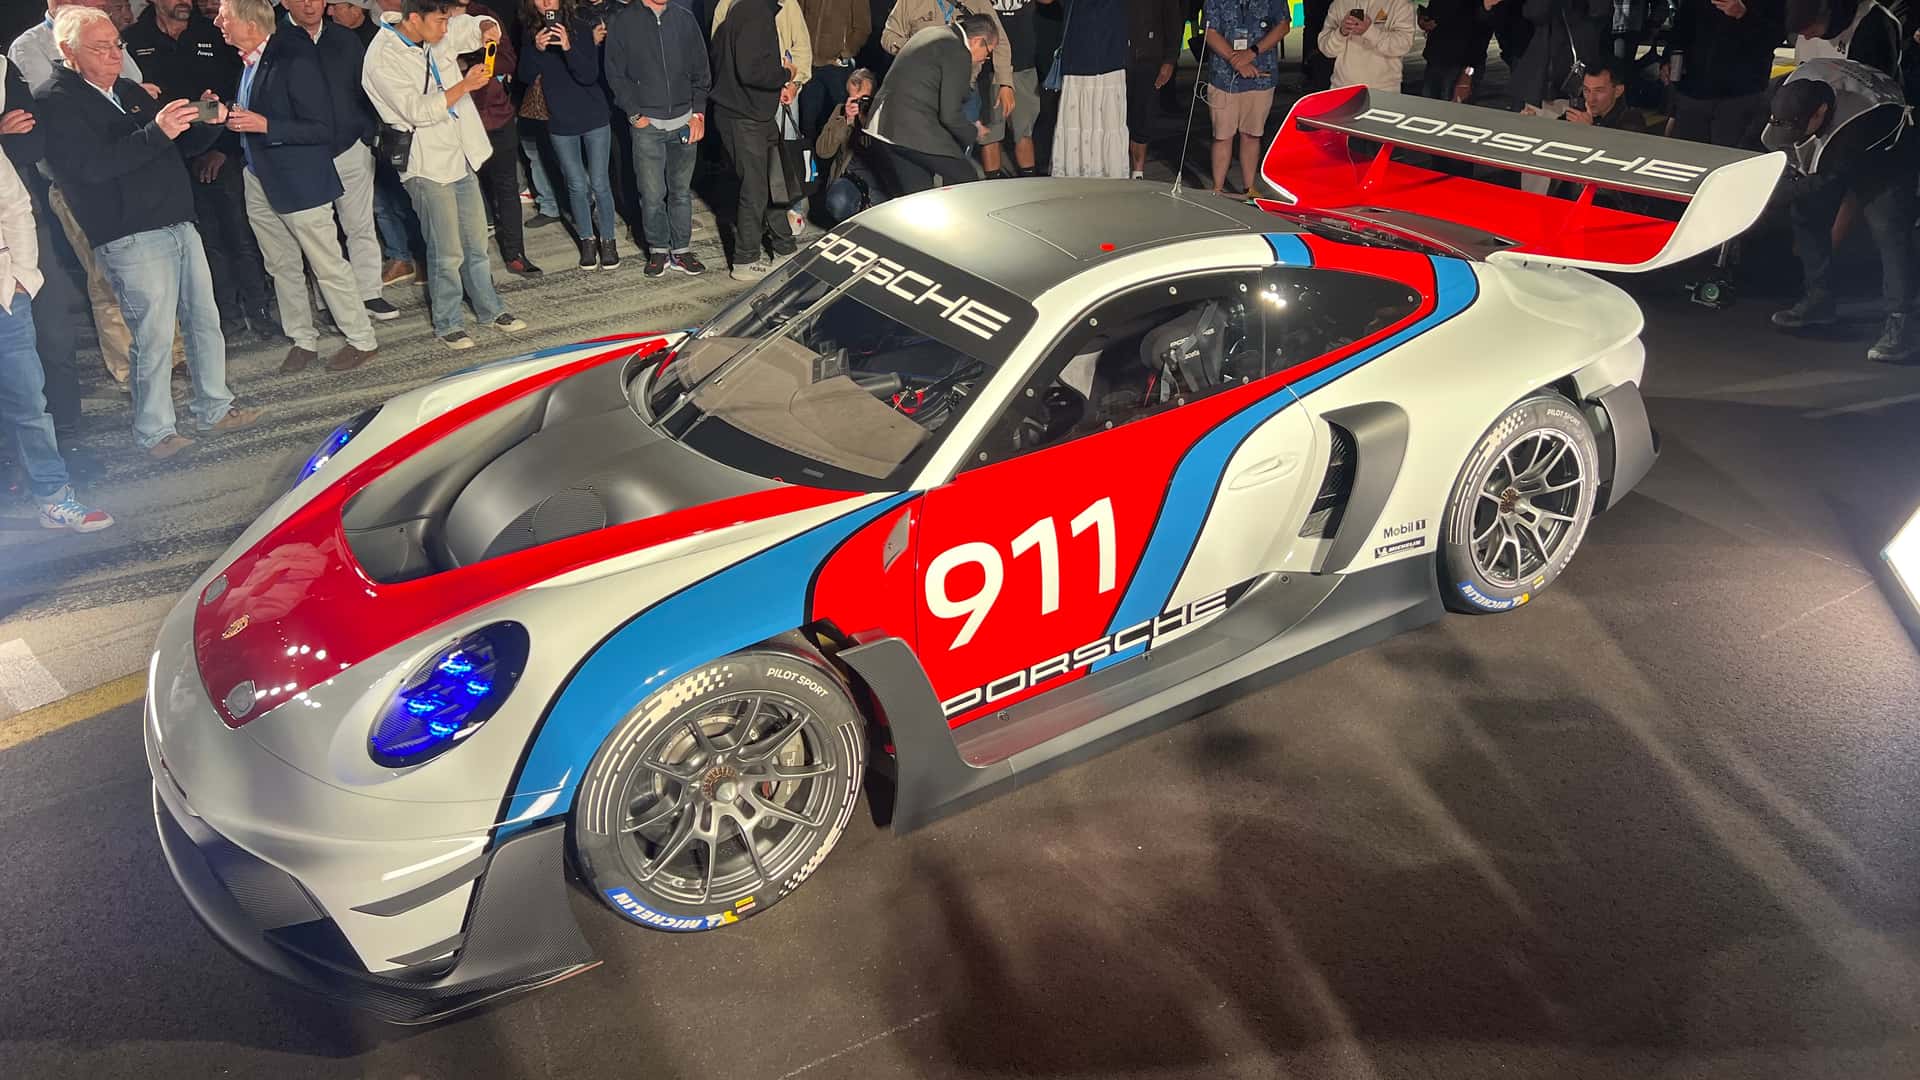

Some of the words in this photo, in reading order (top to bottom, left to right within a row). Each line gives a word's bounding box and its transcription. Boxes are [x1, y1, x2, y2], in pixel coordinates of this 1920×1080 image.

[1354, 108, 1708, 182] PORSCHE
[808, 232, 1011, 340] PORSCHE
[1383, 522, 1413, 539] Mobil
[924, 496, 1117, 651] 911
[1462, 584, 1512, 609] MICHELIN
[940, 589, 1227, 717] PORSCHE
[766, 667, 799, 681] PILOT
[796, 675, 829, 697] SPORT
[612, 892, 703, 929] MICHELIN
